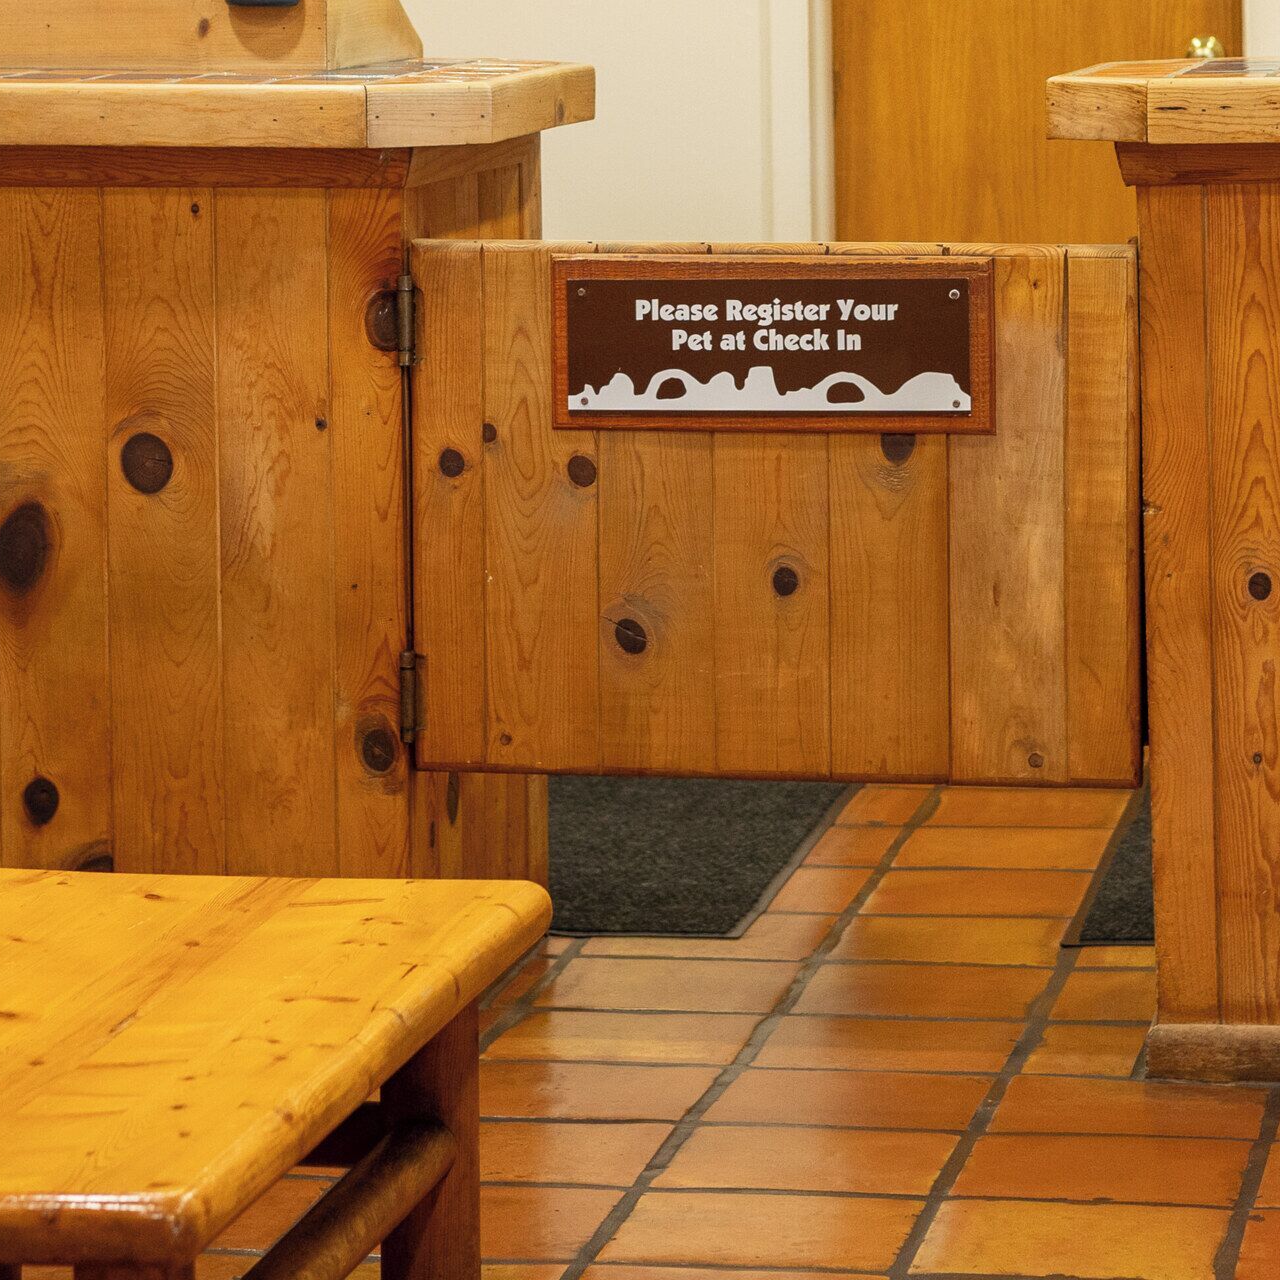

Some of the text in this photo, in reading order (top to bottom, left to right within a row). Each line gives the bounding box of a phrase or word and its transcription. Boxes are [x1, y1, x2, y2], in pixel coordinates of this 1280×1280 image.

[635, 297, 899, 326] Please Register Your
[671, 328, 862, 351] Pet at Check In
